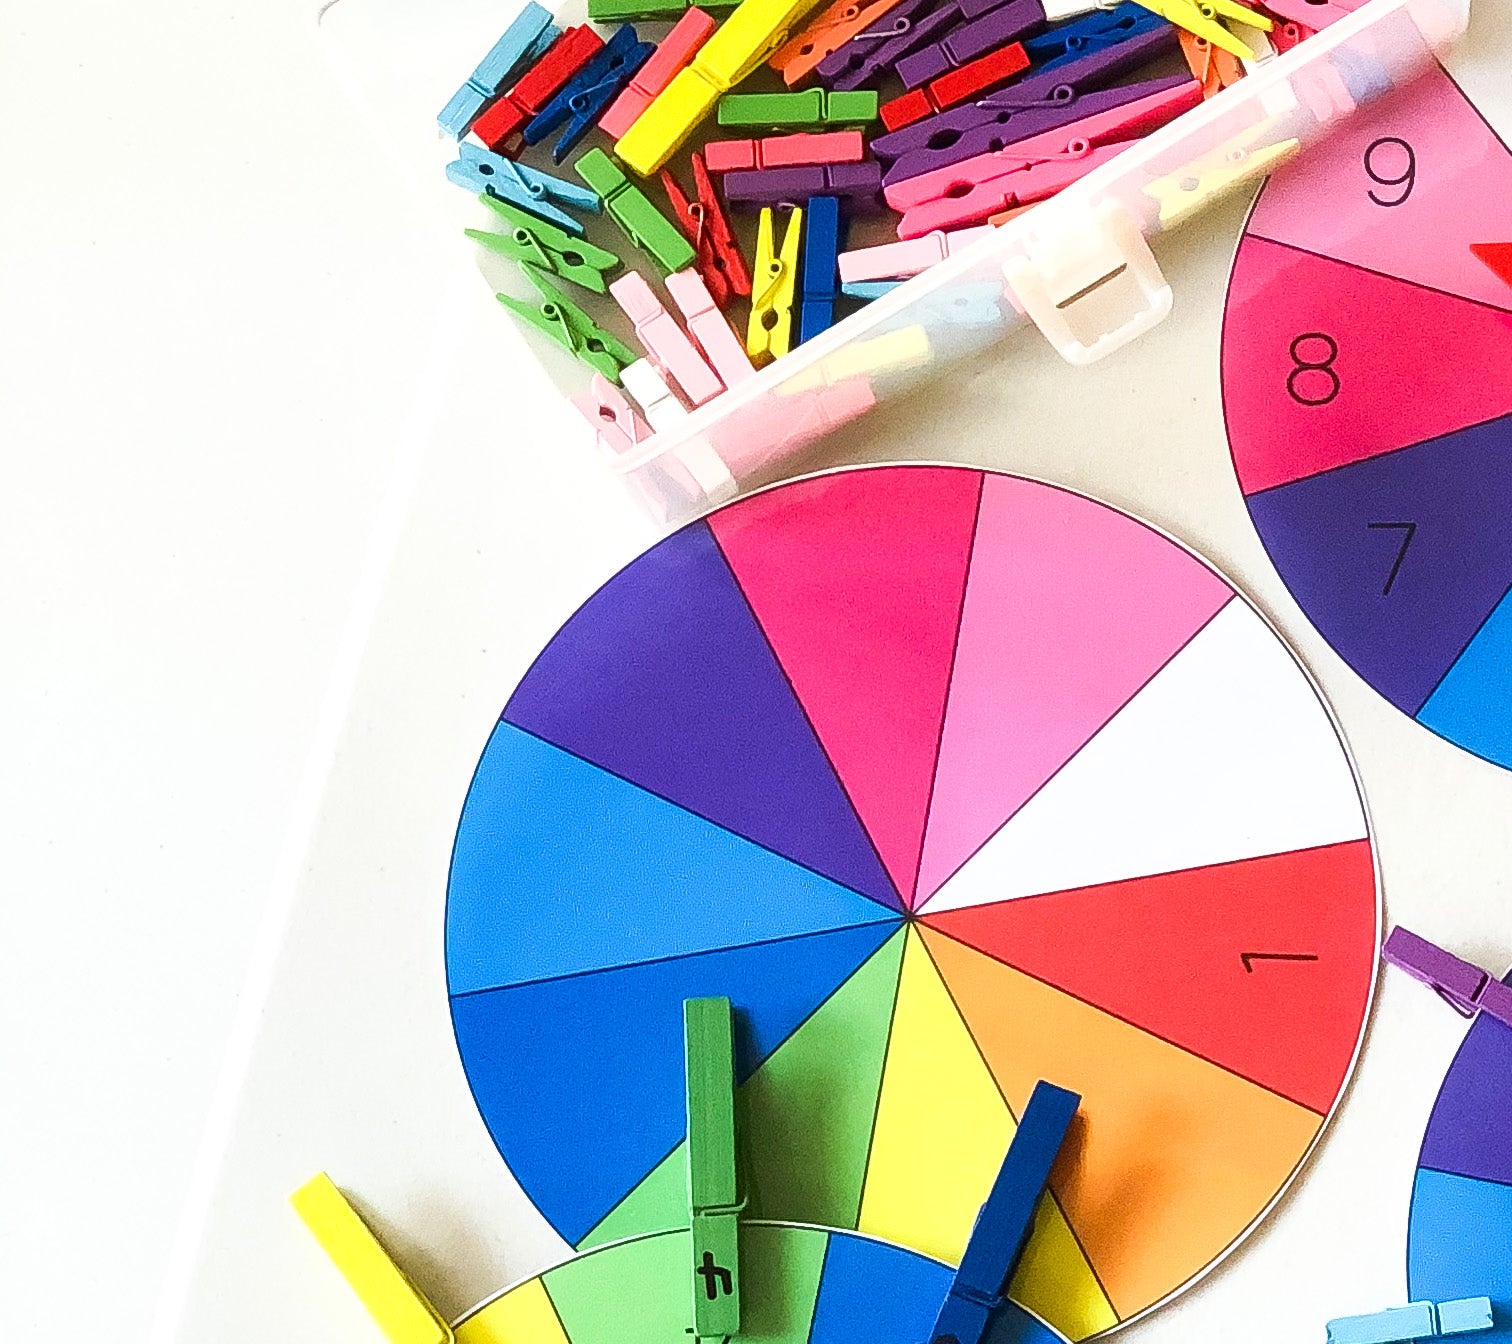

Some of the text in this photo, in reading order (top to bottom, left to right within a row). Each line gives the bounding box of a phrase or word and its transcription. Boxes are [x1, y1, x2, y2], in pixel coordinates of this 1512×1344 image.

[1363, 136, 1416, 208] 9
[1286, 332, 1341, 407] 8
[1367, 522, 1417, 596] 7
[1240, 952, 1319, 973] 1
[697, 1251, 733, 1301] 4
